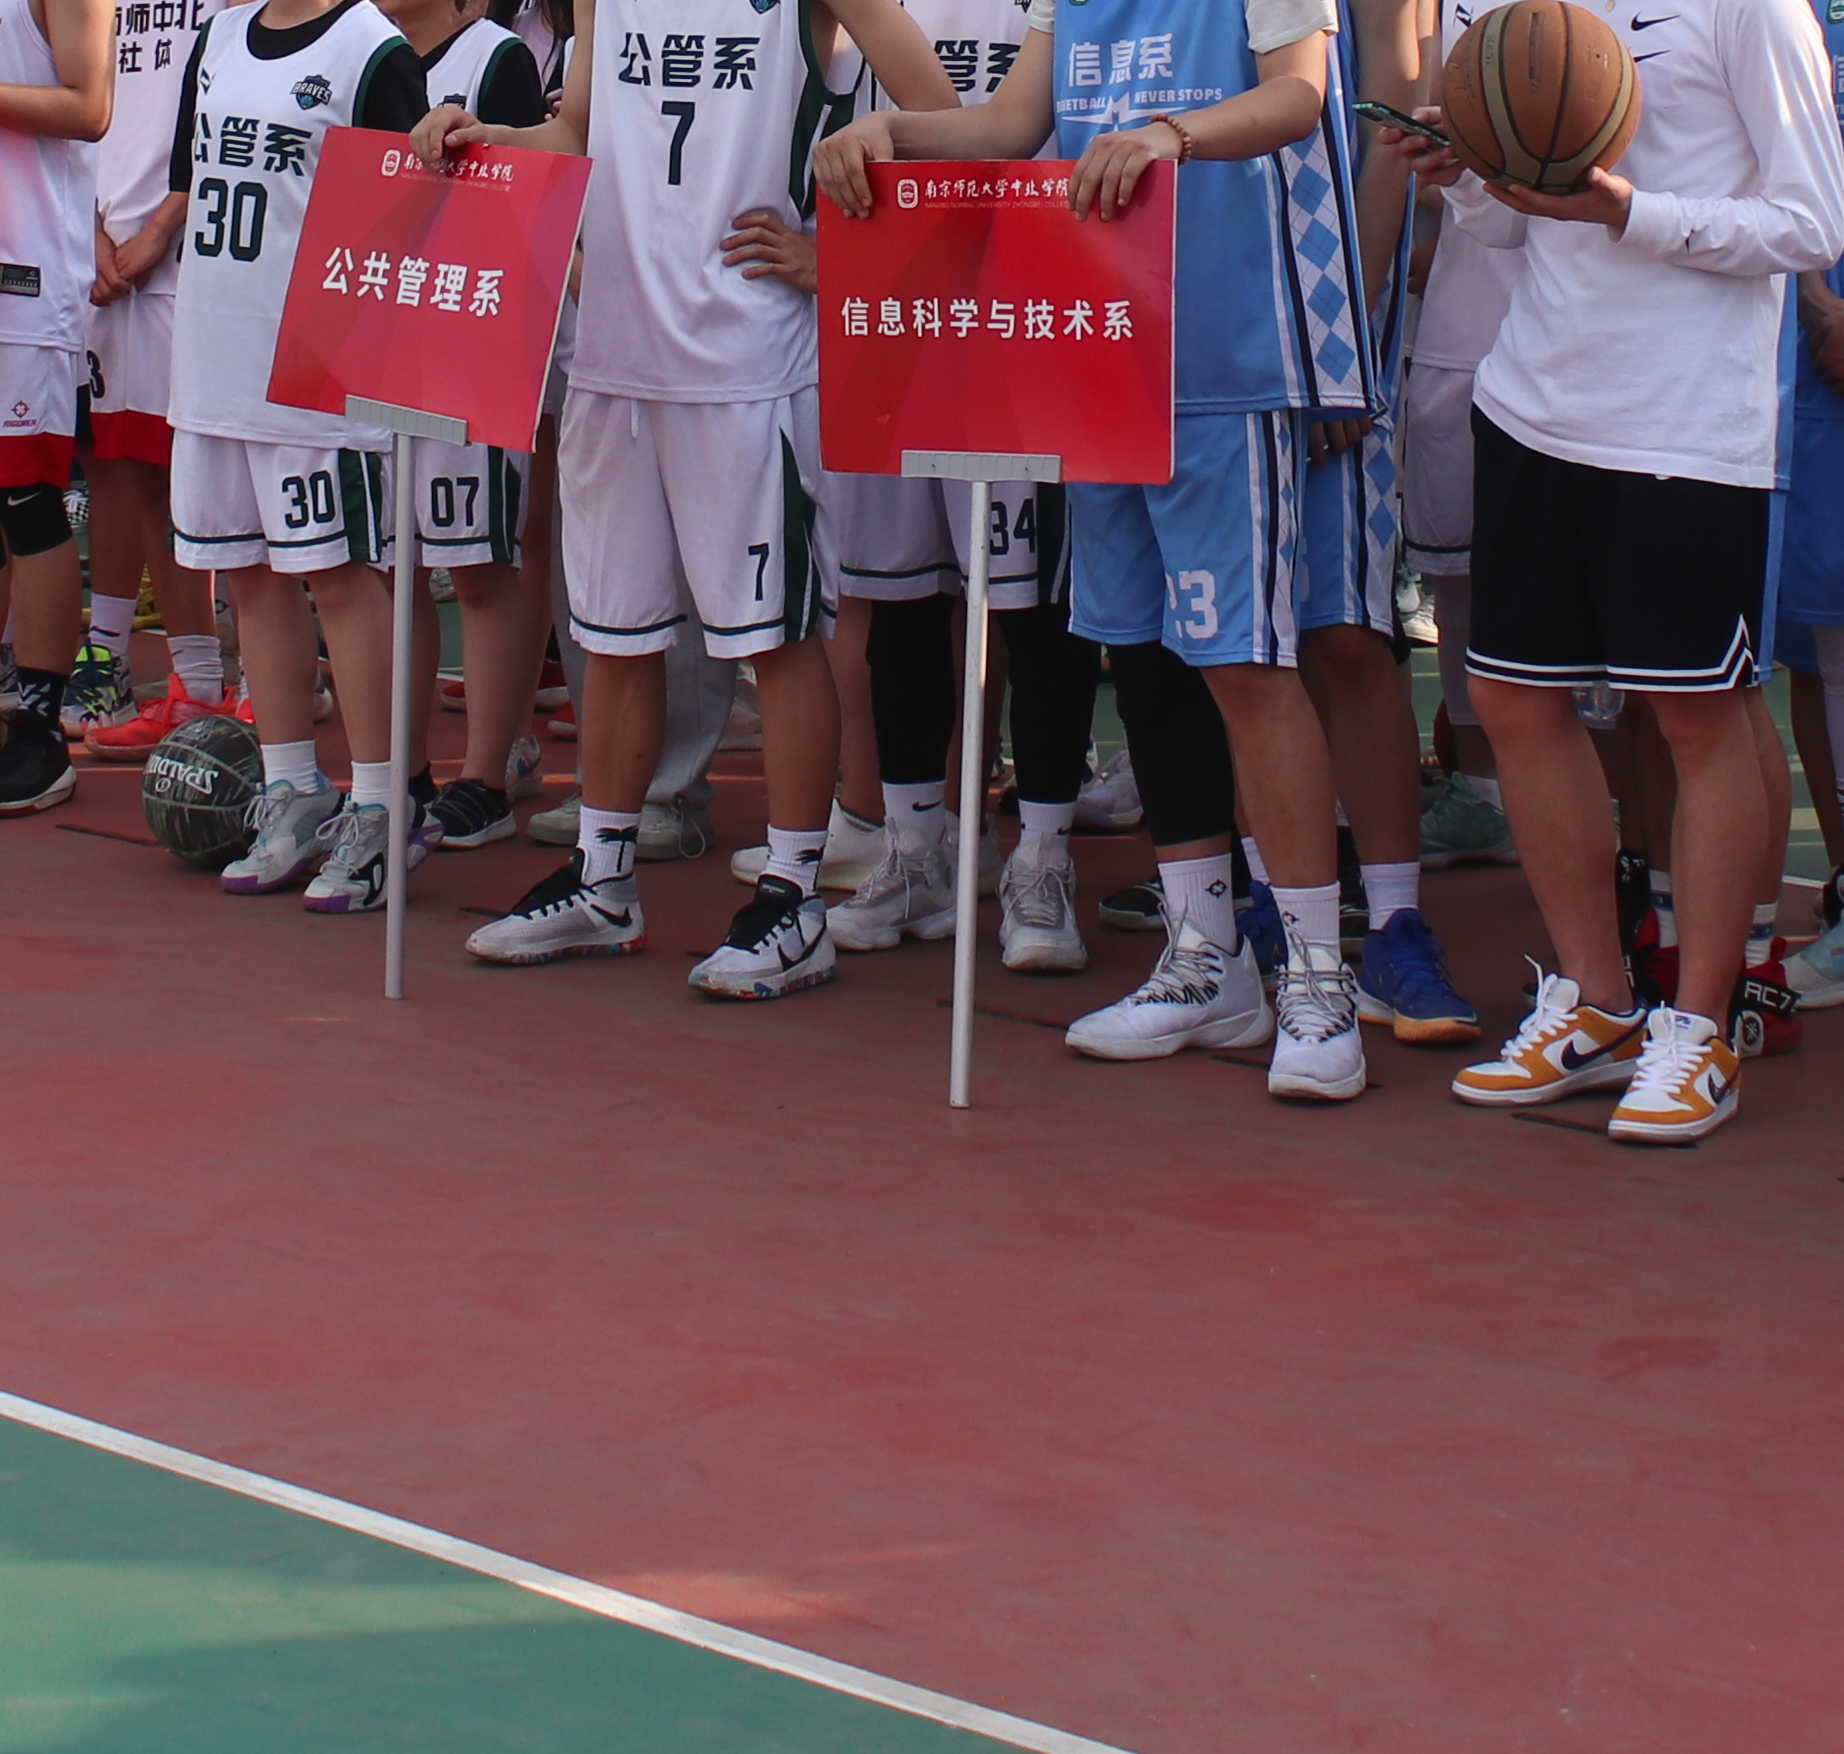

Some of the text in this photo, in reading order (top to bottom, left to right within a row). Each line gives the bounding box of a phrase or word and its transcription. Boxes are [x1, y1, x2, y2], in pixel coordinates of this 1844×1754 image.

[618, 32, 761, 91] 公管系
[1067, 33, 1175, 88] 信息系
[290, 81, 331, 106] BRAVES
[1133, 90, 1175, 104] NEVER
[1178, 88, 1223, 101] STOPS
[661, 101, 696, 186] 7
[194, 177, 268, 263] 30
[321, 246, 502, 319] 公共管理系
[841, 296, 1135, 343] 信息科学与技术系
[281, 470, 334, 529] 30
[430, 476, 480, 529] 07
[988, 501, 1037, 556] 34
[747, 543, 770, 602] 7
